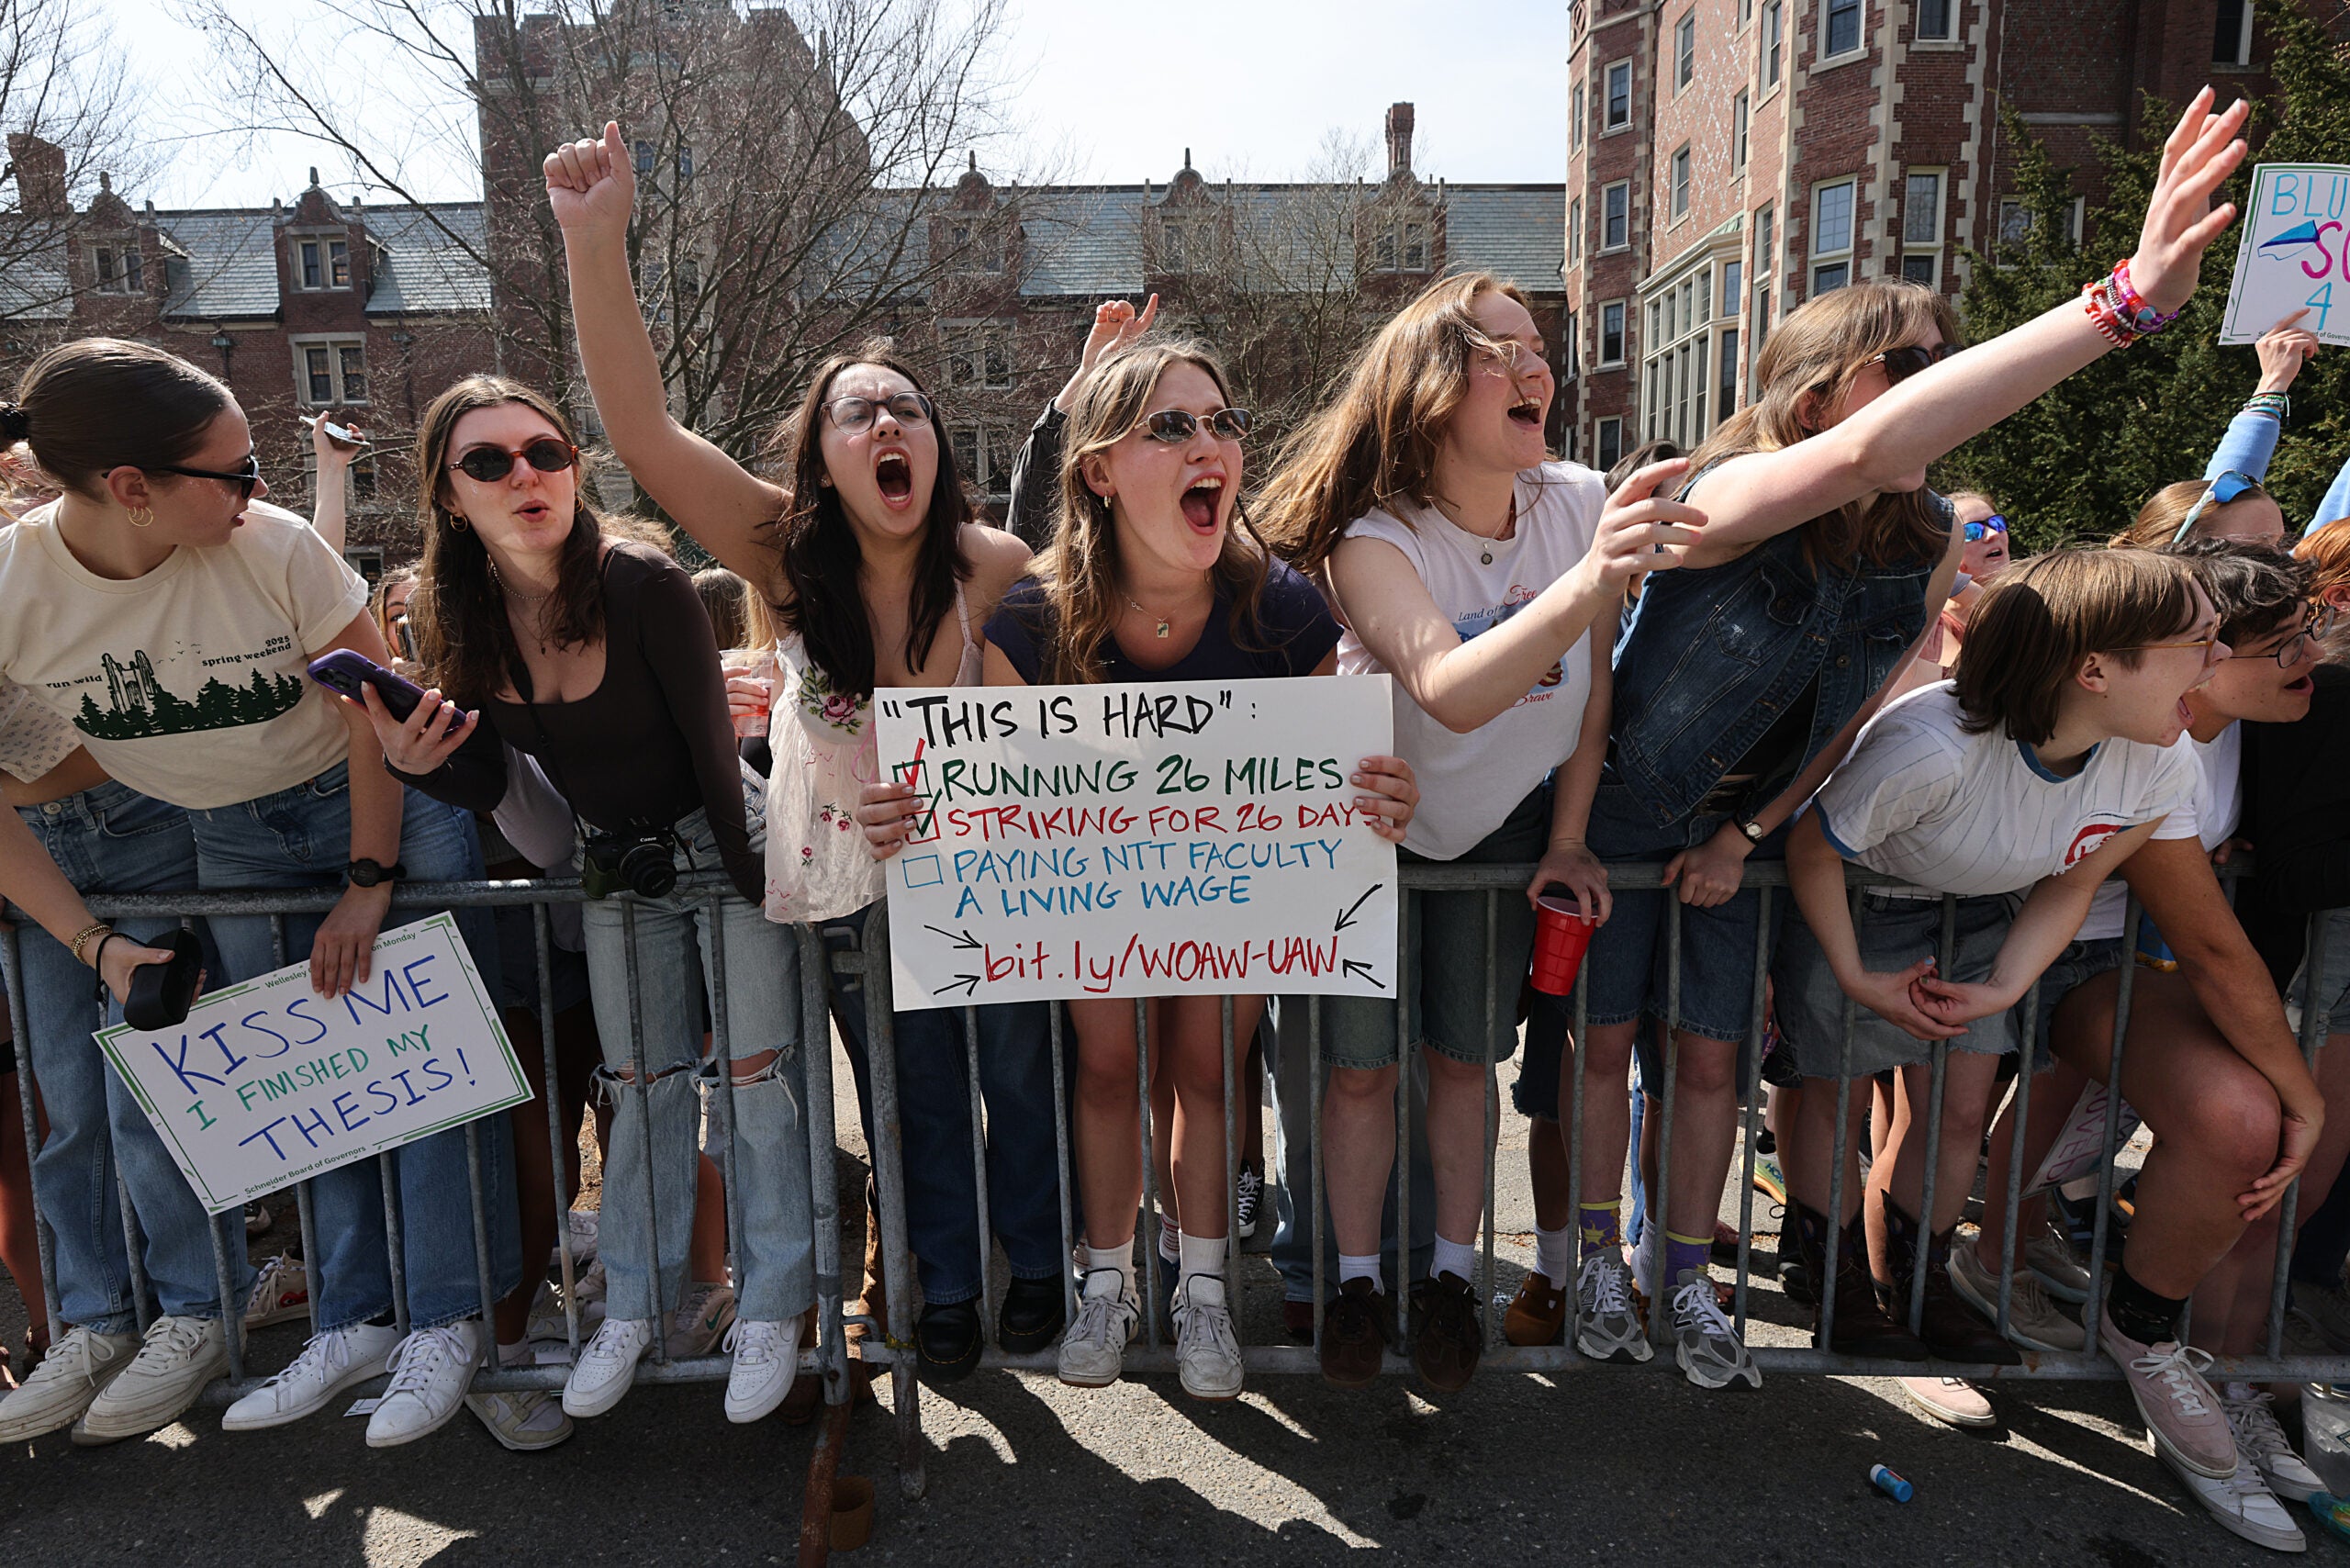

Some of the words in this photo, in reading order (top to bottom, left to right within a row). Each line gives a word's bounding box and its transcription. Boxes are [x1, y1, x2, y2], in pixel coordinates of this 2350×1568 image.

[2305, 281, 2333, 330] 4
[1459, 608, 1484, 622] Land
[1487, 605, 1499, 617] of
[201, 653, 242, 667] spring
[243, 643, 292, 662] weekend
[264, 635, 291, 646] 2025
[47, 680, 71, 689] run
[73, 675, 104, 686] wild
[1040, 696, 1079, 739] IS
[942, 759, 1139, 801] RUNNING
[1156, 754, 1209, 794] 26
[1225, 757, 1344, 795] MILES
[947, 804, 1139, 842] STRIKING
[1148, 805, 1228, 836] FOR
[1237, 803, 1282, 831] 26
[953, 848, 1090, 883] PAYING
[1102, 841, 1176, 875] NTT
[1189, 838, 1343, 874] FACULTY
[954, 887, 983, 918] A
[1002, 881, 1122, 916] LIVING
[1141, 875, 1251, 909] WAGE
[383, 932, 417, 947] Monday
[264, 970, 307, 989] Wellesley
[984, 933, 1338, 993] bit.ly/WOAW-UAW
[151, 998, 327, 1095] KISS
[342, 955, 449, 1025] ME
[186, 1100, 217, 1132] I
[236, 1047, 369, 1112] FINISHED
[386, 1024, 431, 1058] MY
[238, 1047, 476, 1160] THESIS!
[244, 1174, 287, 1194] Schneider
[288, 1165, 314, 1178] Board
[314, 1160, 324, 1169] of
[324, 1146, 366, 1164] Governors
